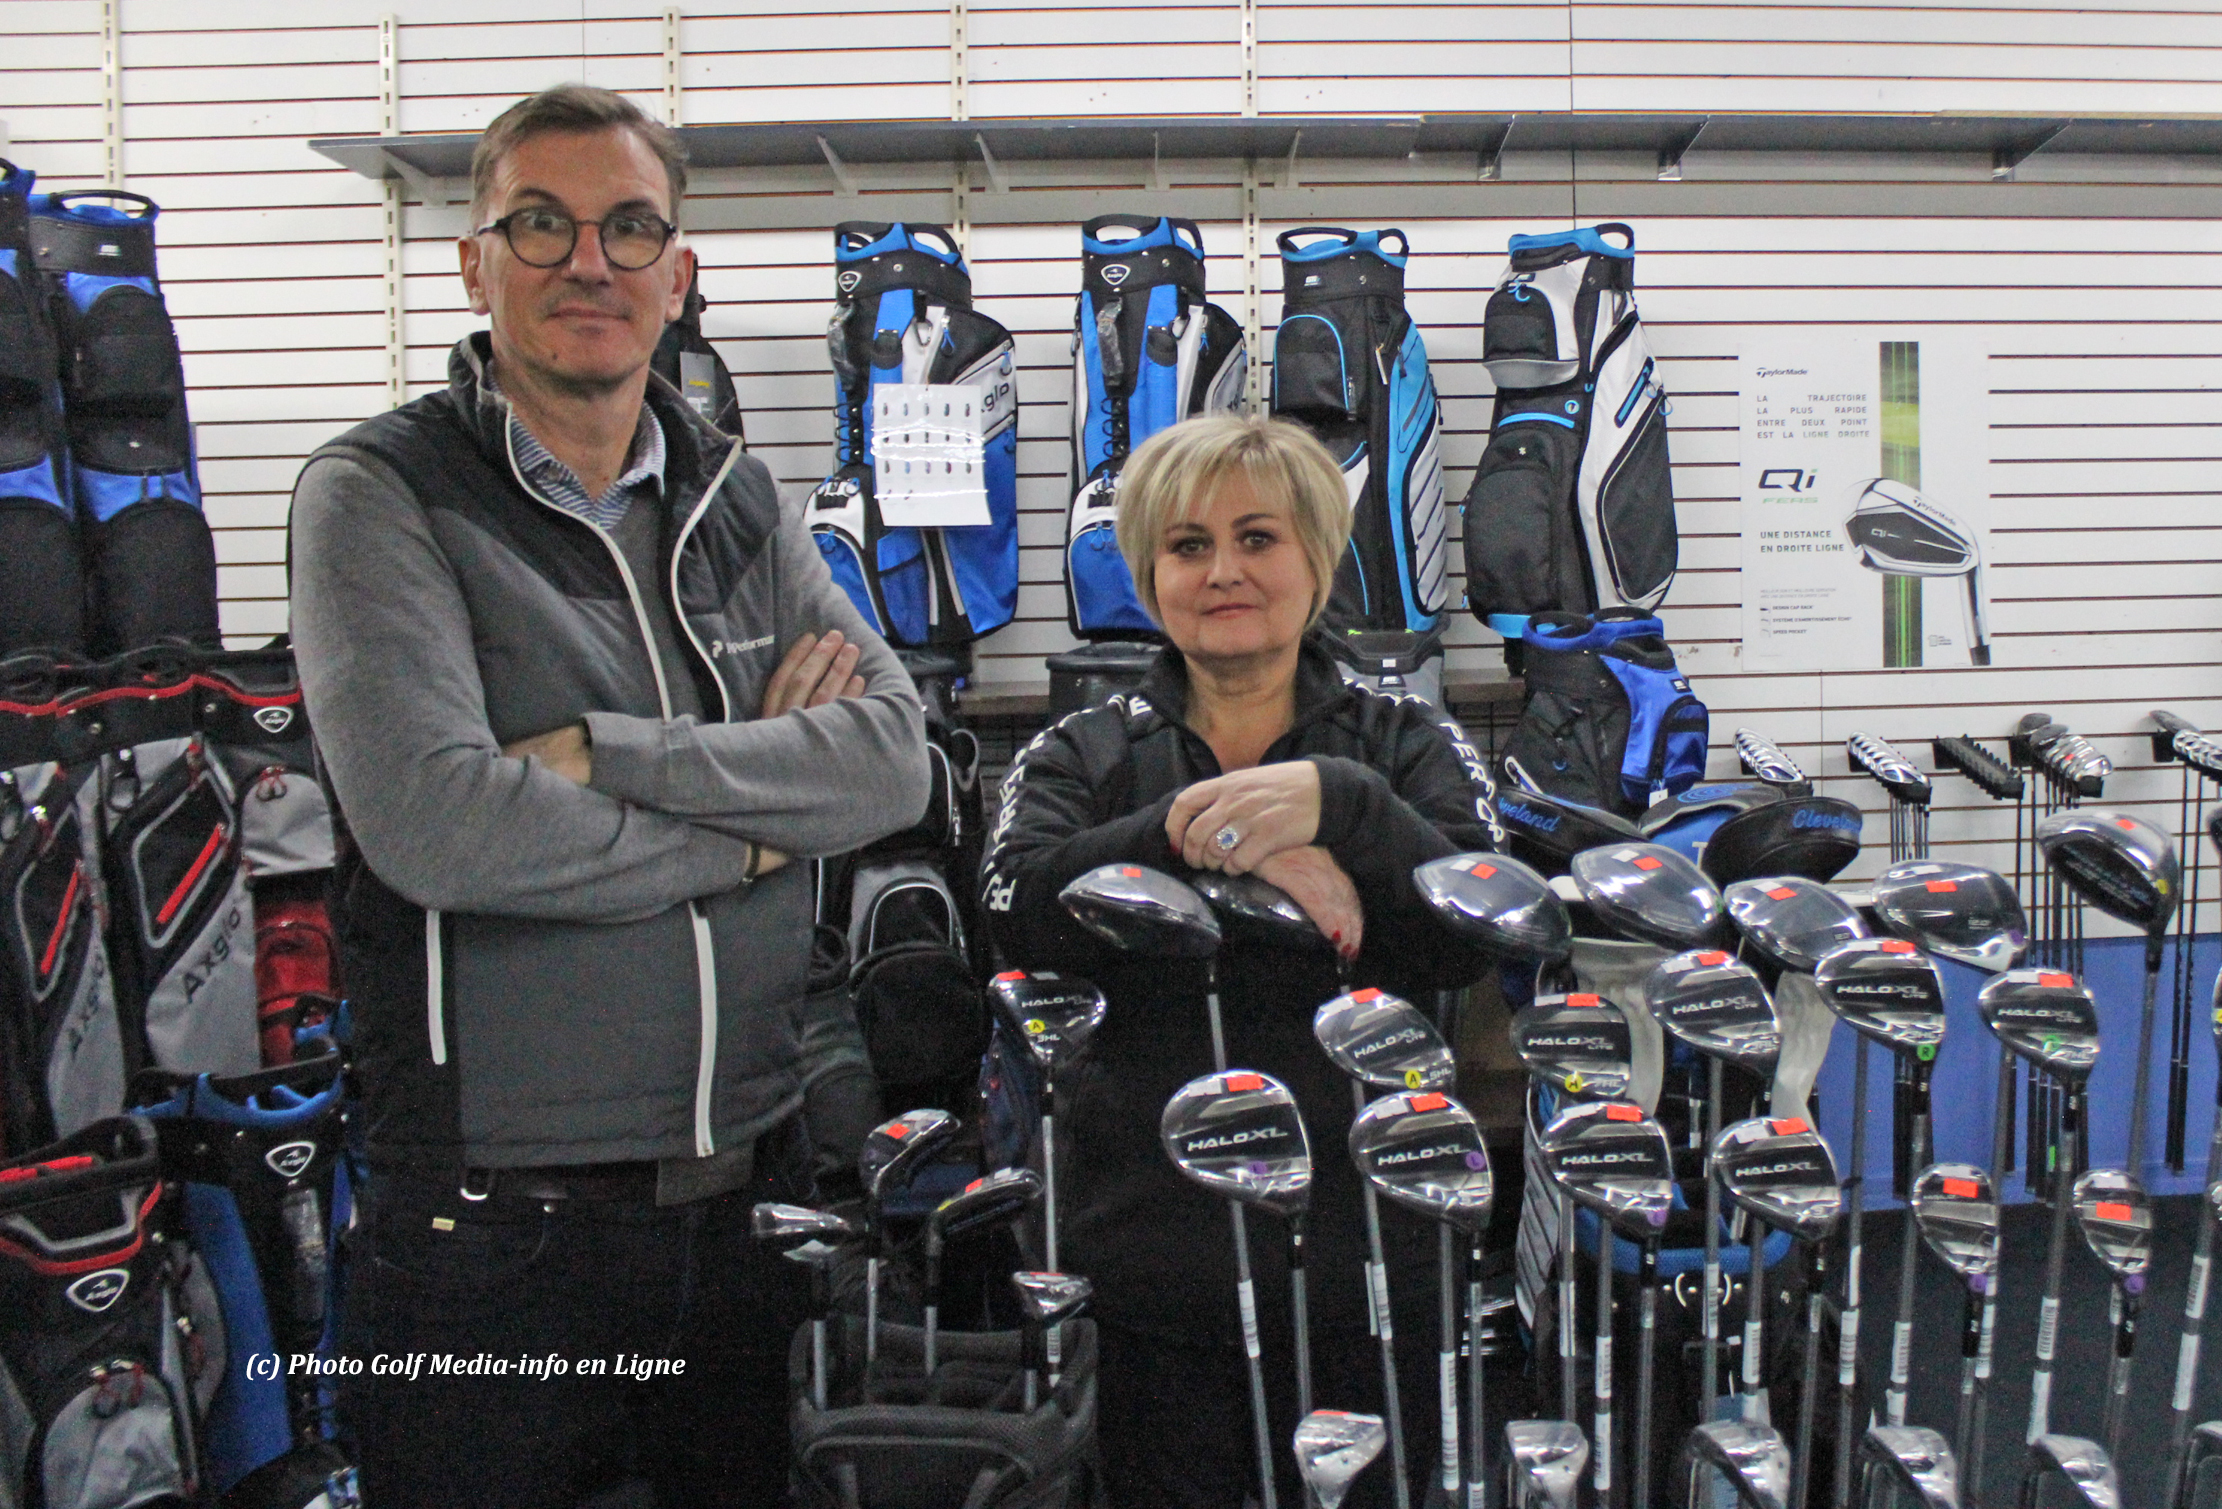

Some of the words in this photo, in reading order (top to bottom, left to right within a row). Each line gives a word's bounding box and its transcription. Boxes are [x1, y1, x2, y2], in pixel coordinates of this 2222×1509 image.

[1756, 367, 1808, 378] TaylorMade
[981, 382, 1010, 413] glo
[1807, 394, 1867, 402] TRAJECTOIRE
[1790, 406, 1813, 414] PLUS
[1834, 406, 1867, 414] RAPIDE
[1757, 419, 1786, 427] ENTRE
[1840, 418, 1867, 426] POINT
[1757, 431, 1774, 439] EST
[1837, 430, 1870, 438] DROITE
[1758, 468, 1818, 493] Qi
[1760, 531, 1780, 539] UNE
[1783, 530, 1832, 538] DISTANCE
[1760, 545, 1773, 553] EN
[1776, 544, 1812, 552] DROITE
[1815, 543, 1845, 552] LIGNE
[184, 906, 241, 1005] Axglo
